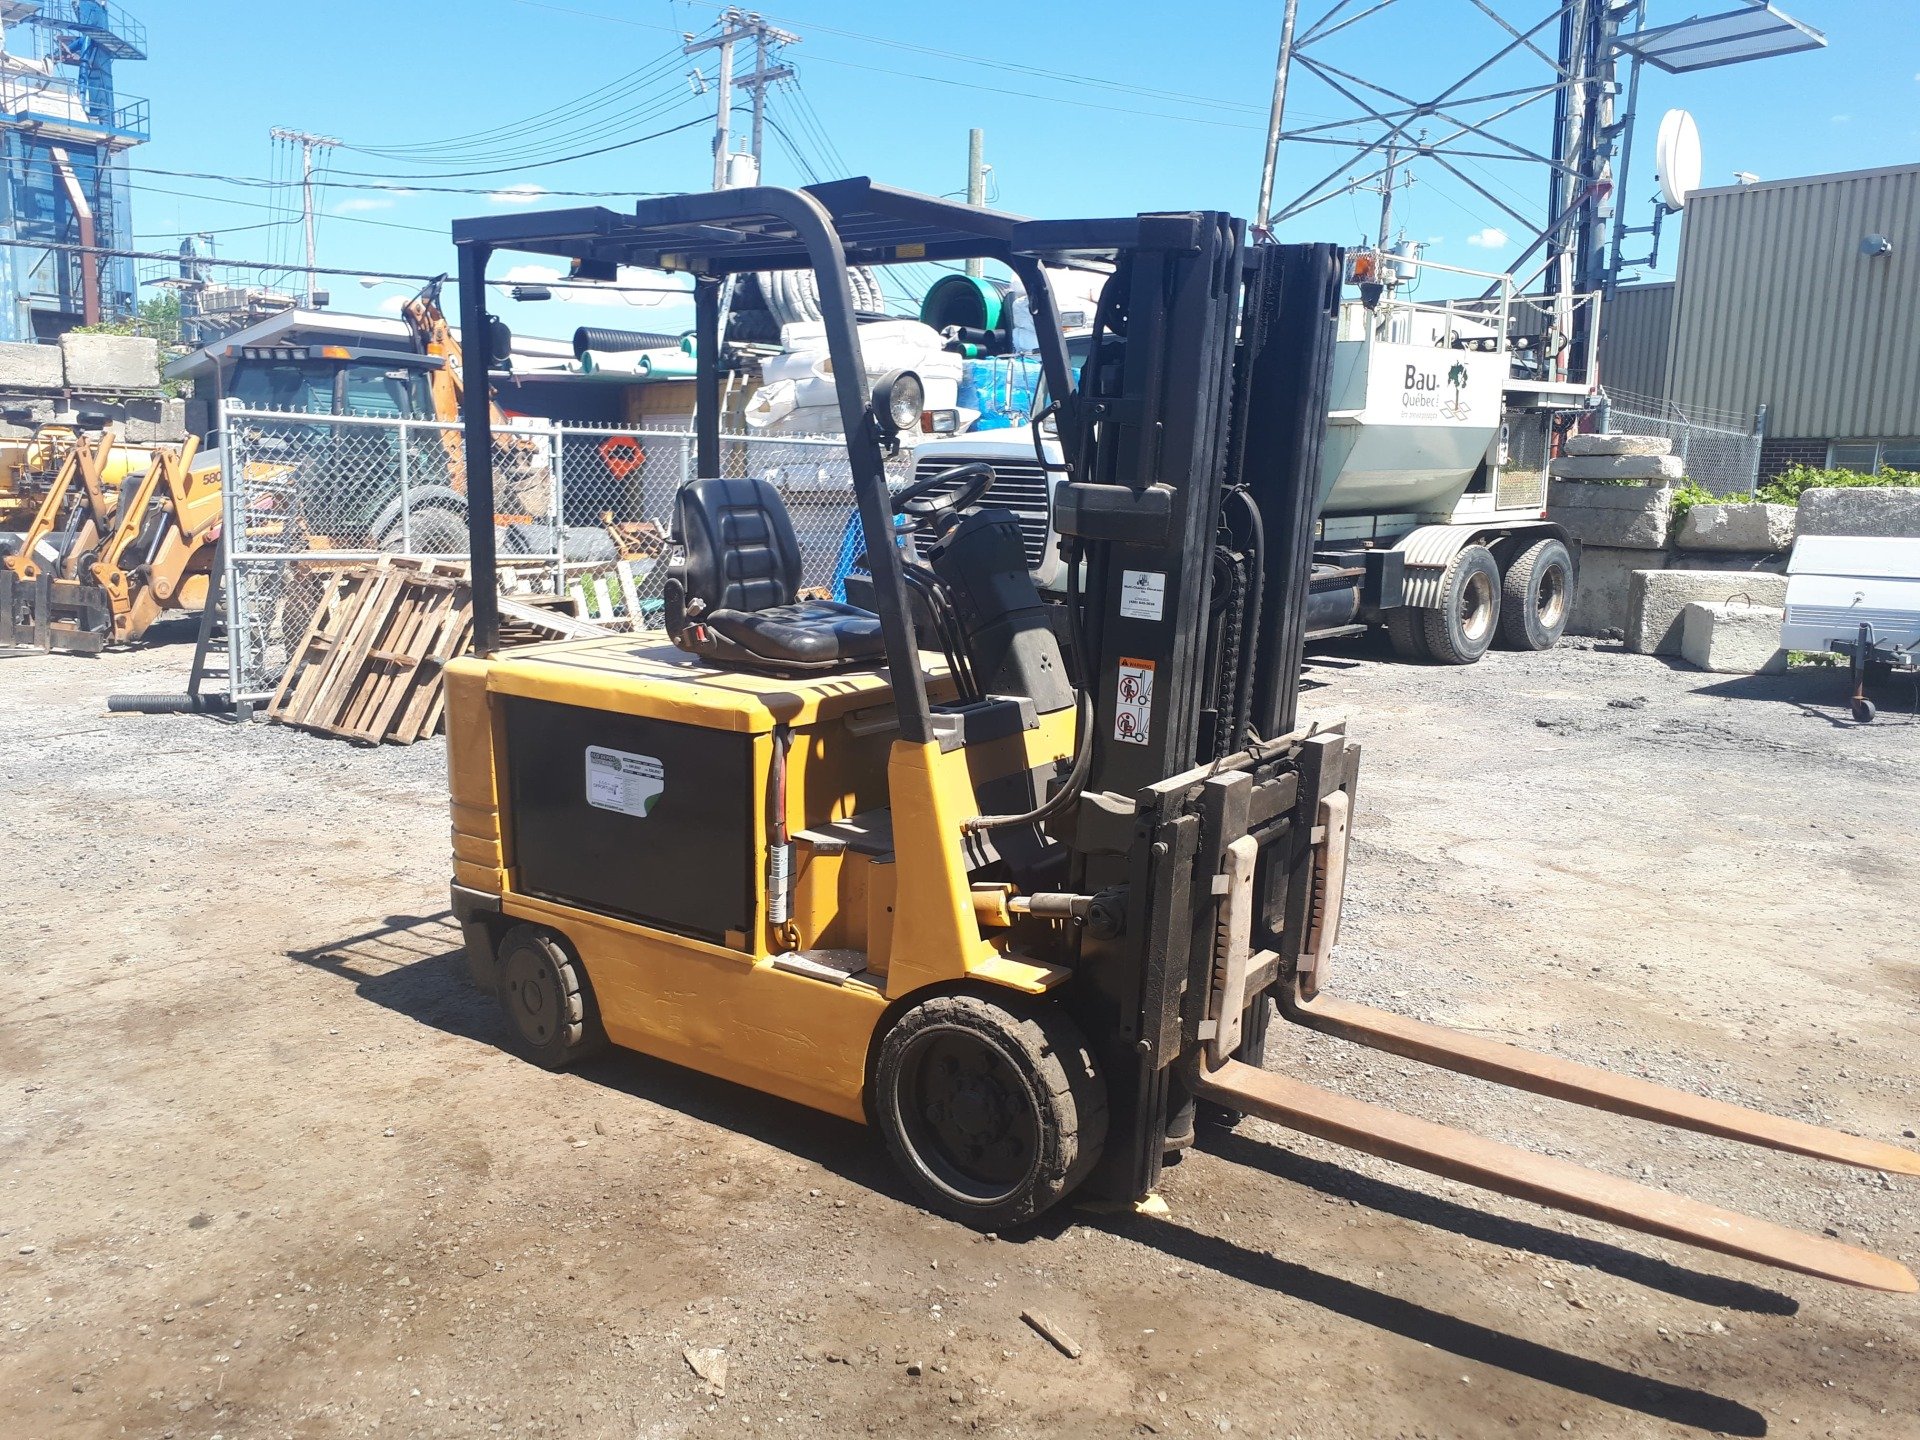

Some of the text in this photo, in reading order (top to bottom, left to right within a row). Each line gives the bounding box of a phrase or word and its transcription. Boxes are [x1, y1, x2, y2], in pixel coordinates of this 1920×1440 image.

[1402, 392, 1435, 408] Québec
[203, 471, 222, 485] 580
[1129, 663, 1151, 671] WARNING
